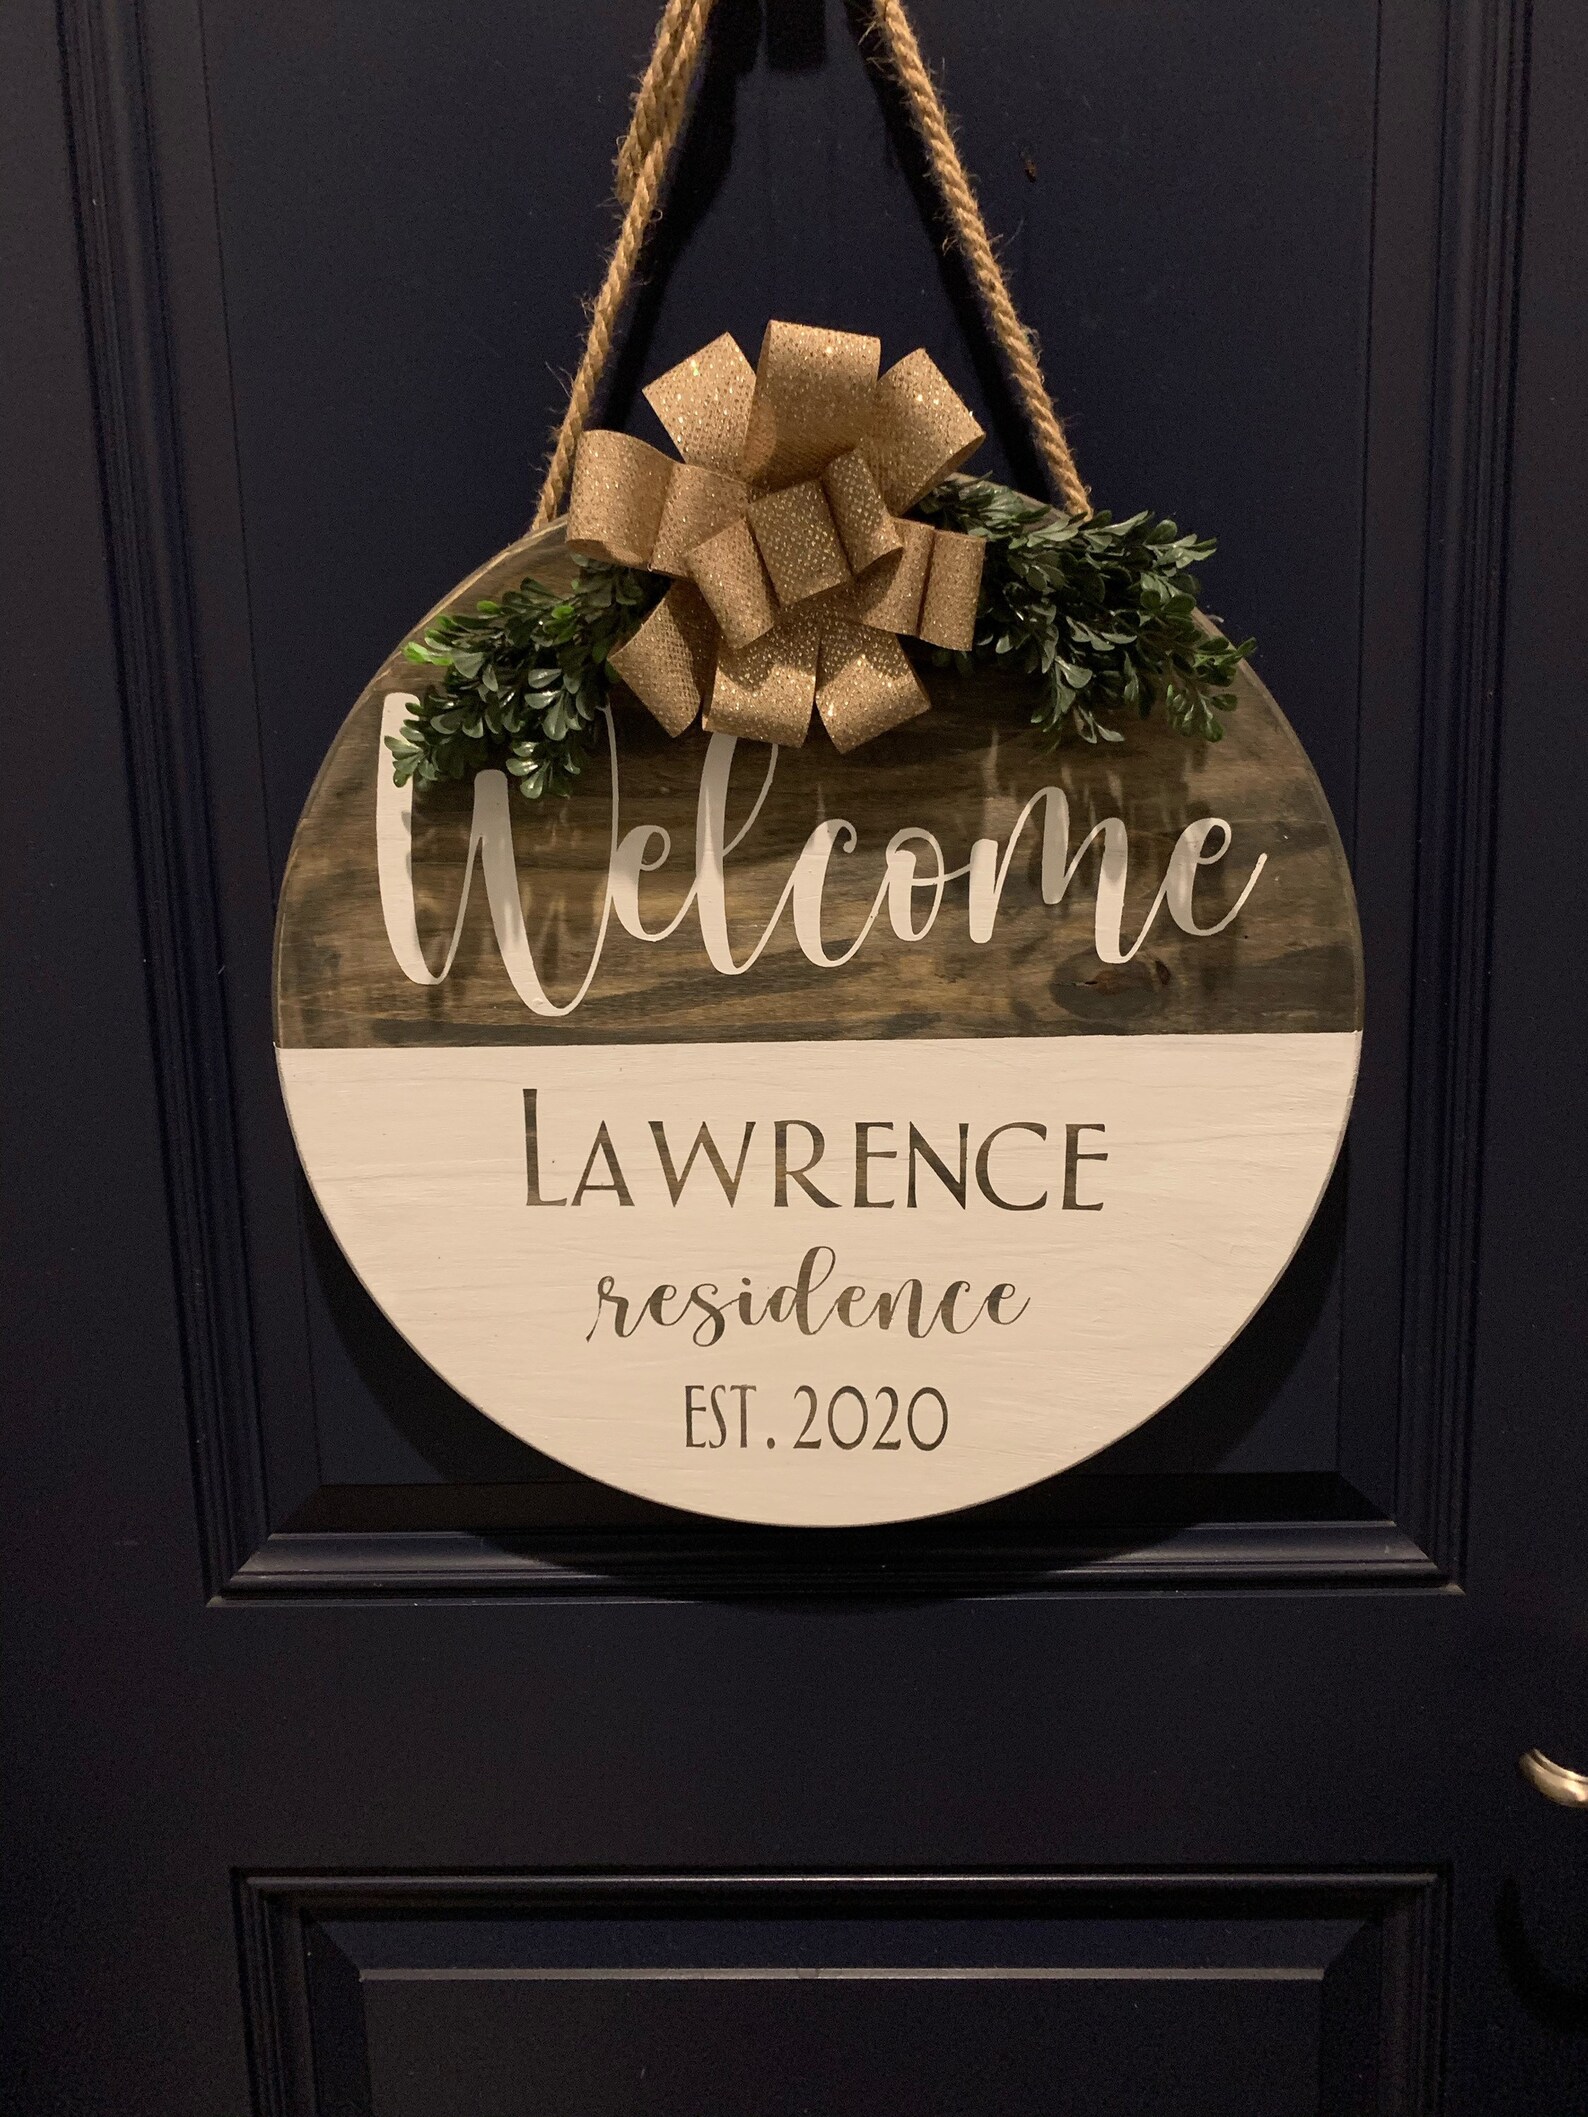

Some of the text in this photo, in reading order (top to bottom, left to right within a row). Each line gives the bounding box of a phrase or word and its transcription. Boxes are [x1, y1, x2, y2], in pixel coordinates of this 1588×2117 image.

[376, 692, 1268, 1017] Welcome
[522, 1088, 1109, 1212] LAWRENCE
[585, 1245, 1031, 1347] residence
[684, 1384, 949, 1452] EST. 2020
